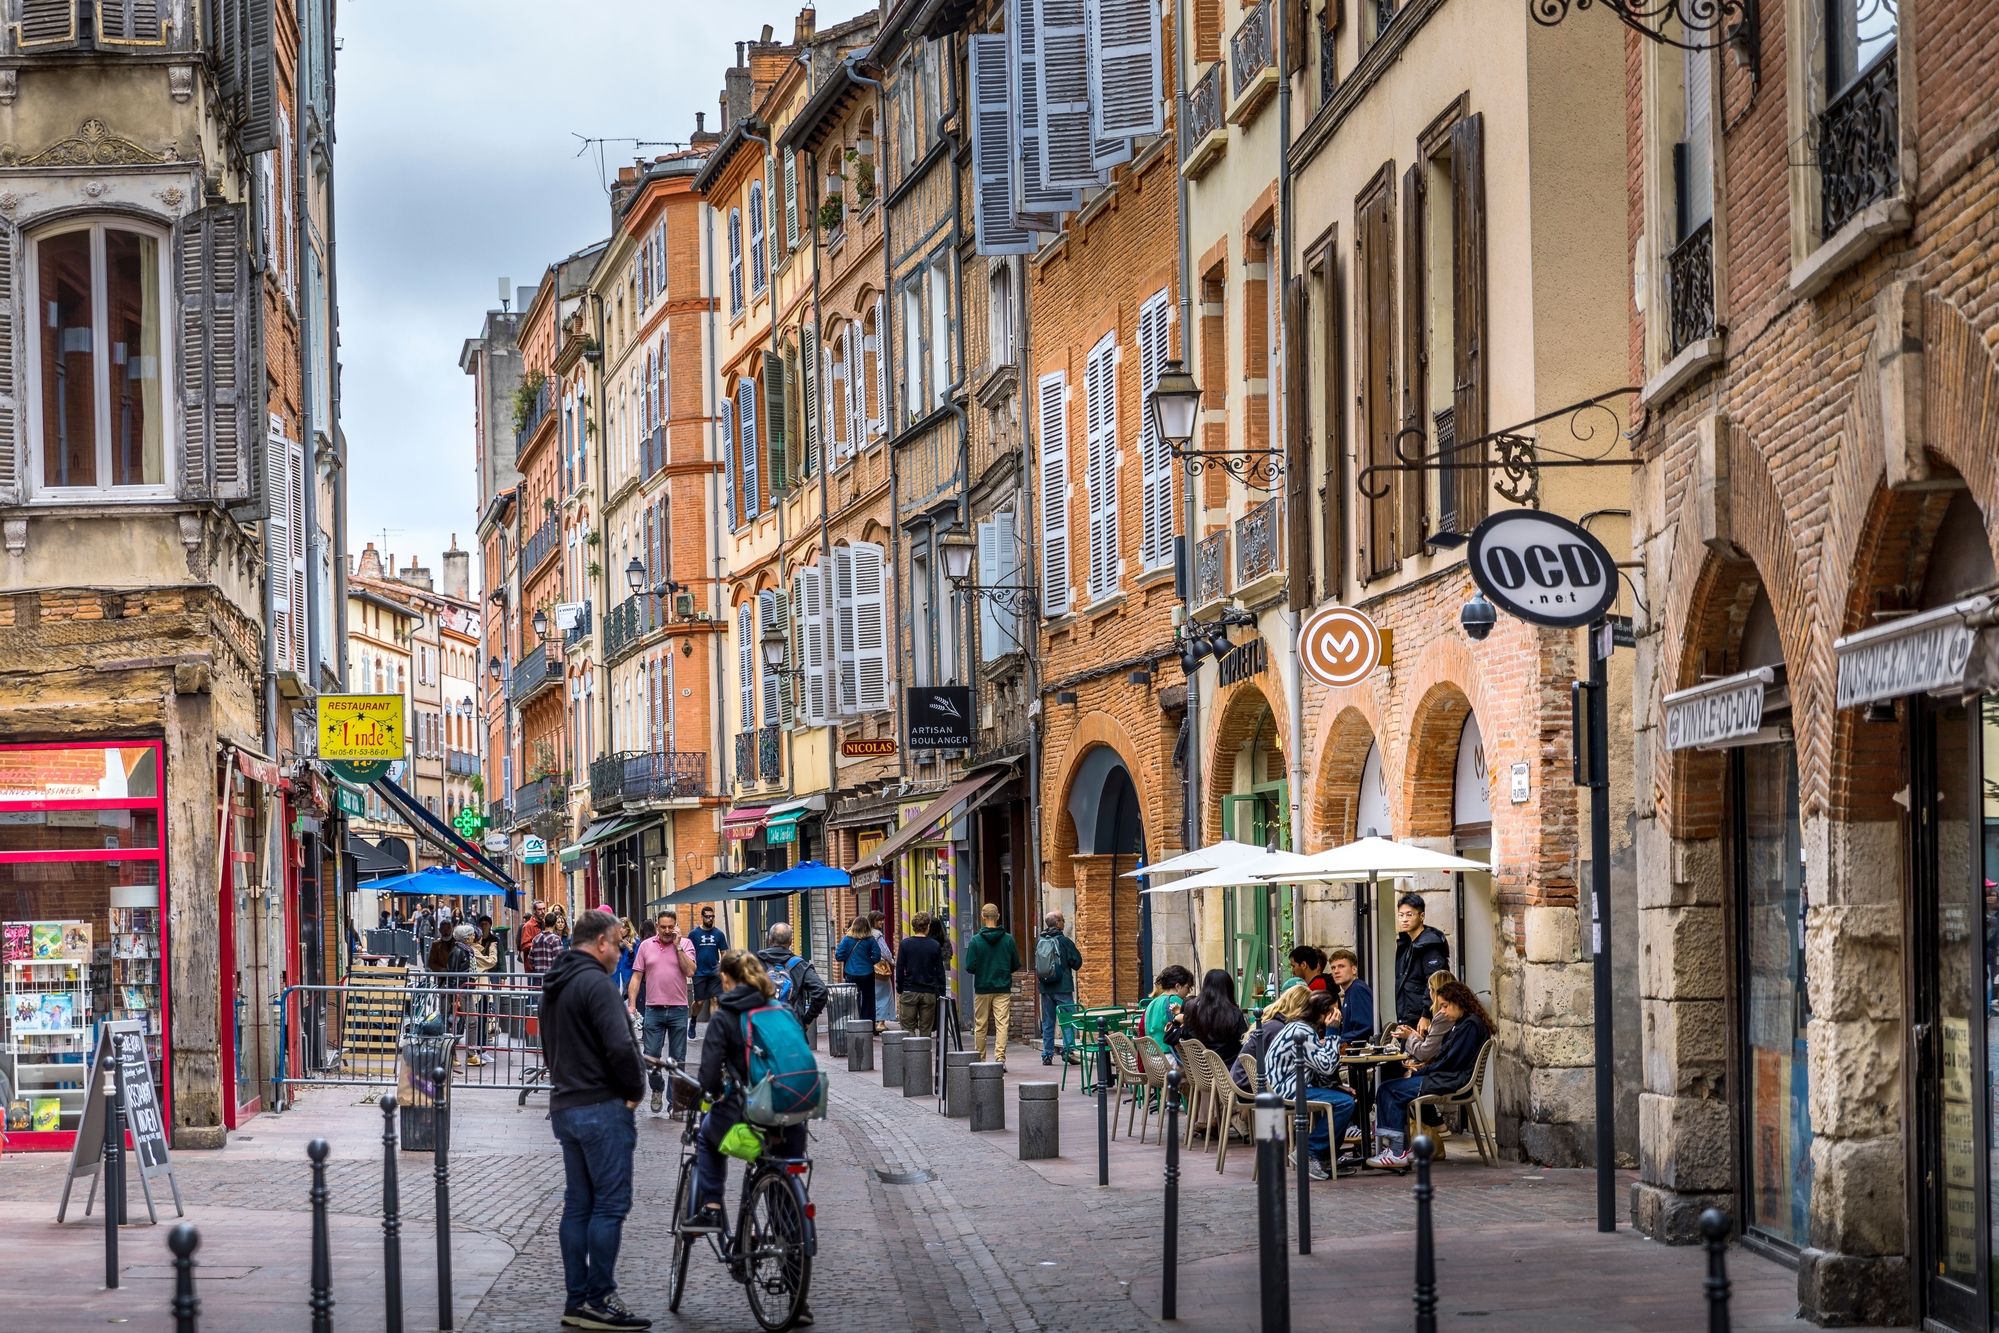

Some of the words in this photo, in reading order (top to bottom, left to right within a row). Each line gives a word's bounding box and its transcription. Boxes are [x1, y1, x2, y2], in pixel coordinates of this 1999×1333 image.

[1486, 544, 1601, 590] OCD
[1529, 592, 1576, 605] .net
[328, 702, 391, 711] RESTAURANT
[911, 726, 953, 735] ARTISAN
[911, 736, 968, 745] BOULANGER
[846, 742, 893, 754] NICOLAS
